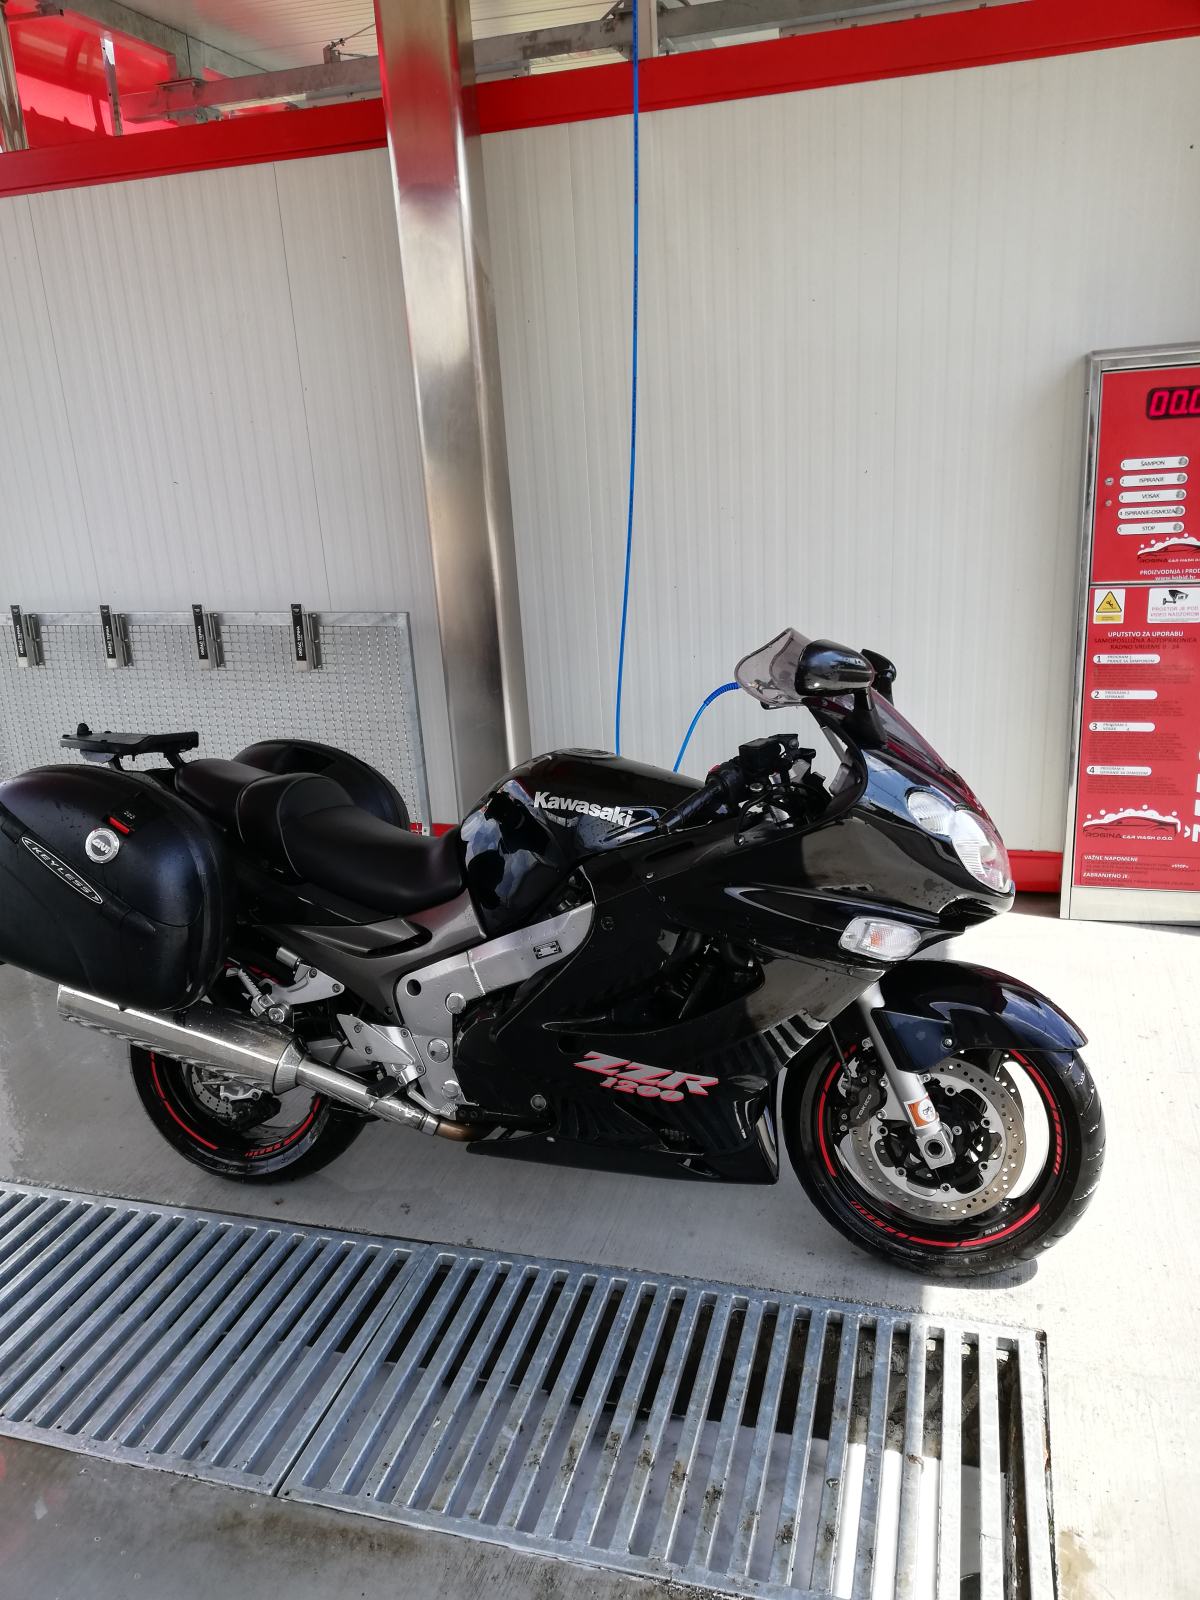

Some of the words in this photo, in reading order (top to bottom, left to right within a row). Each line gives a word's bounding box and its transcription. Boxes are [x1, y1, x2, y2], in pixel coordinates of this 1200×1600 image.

[1139, 568, 1181, 576] PROIZVODNJA
[1096, 655, 1101, 663] 1
[1094, 691, 1100, 699] 2
[1092, 722, 1098, 731] 3
[1089, 766, 1095, 774] 4
[533, 791, 634, 828] Kawasaki
[91, 838, 111, 854] GIVI
[31, 846, 92, 894] KEYLESS
[573, 1050, 719, 1096] ZZR
[600, 1076, 685, 1102] 1200
[856, 1094, 872, 1120] TOKICO
